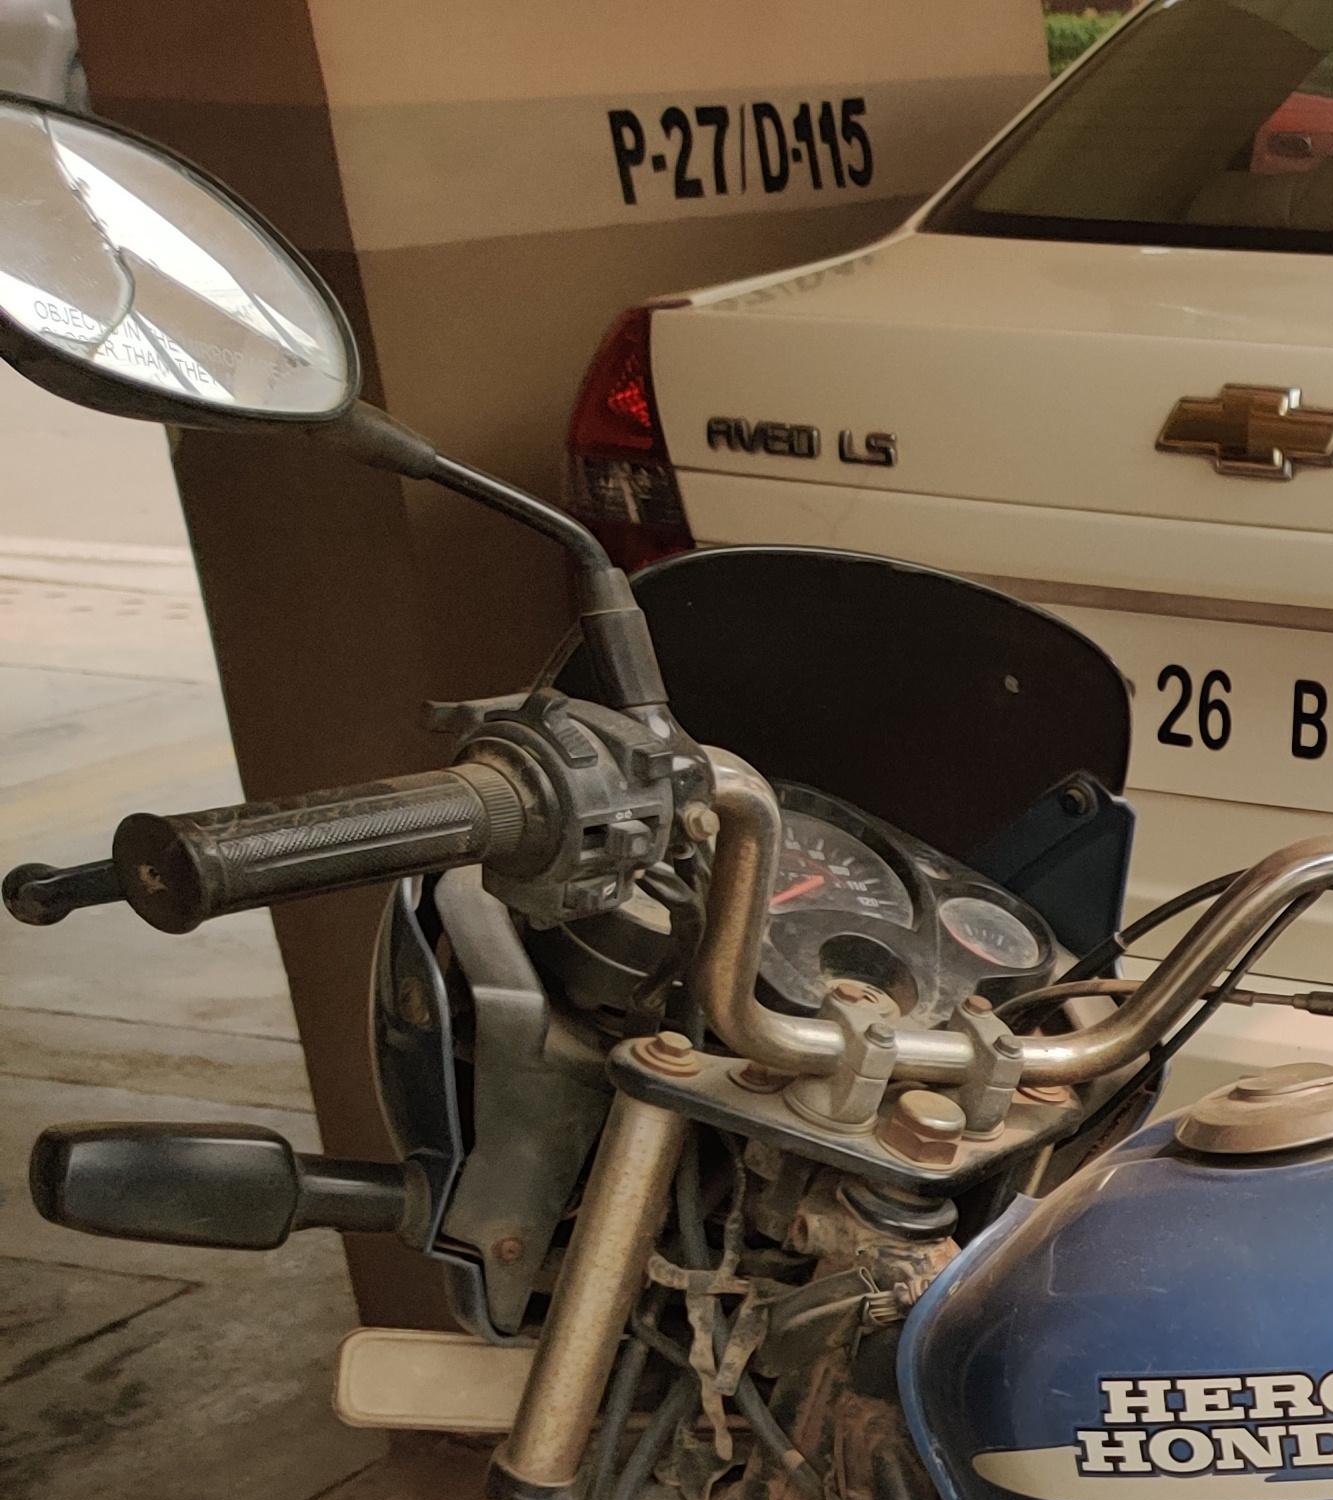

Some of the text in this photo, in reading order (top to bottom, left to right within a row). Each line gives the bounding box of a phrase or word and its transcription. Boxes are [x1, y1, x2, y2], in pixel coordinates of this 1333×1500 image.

[608, 98, 874, 205] P-27/D-115
[122, 319, 142, 341] IN
[707, 416, 898, 468] AVEO LS
[1157, 664, 1232, 751] 26
